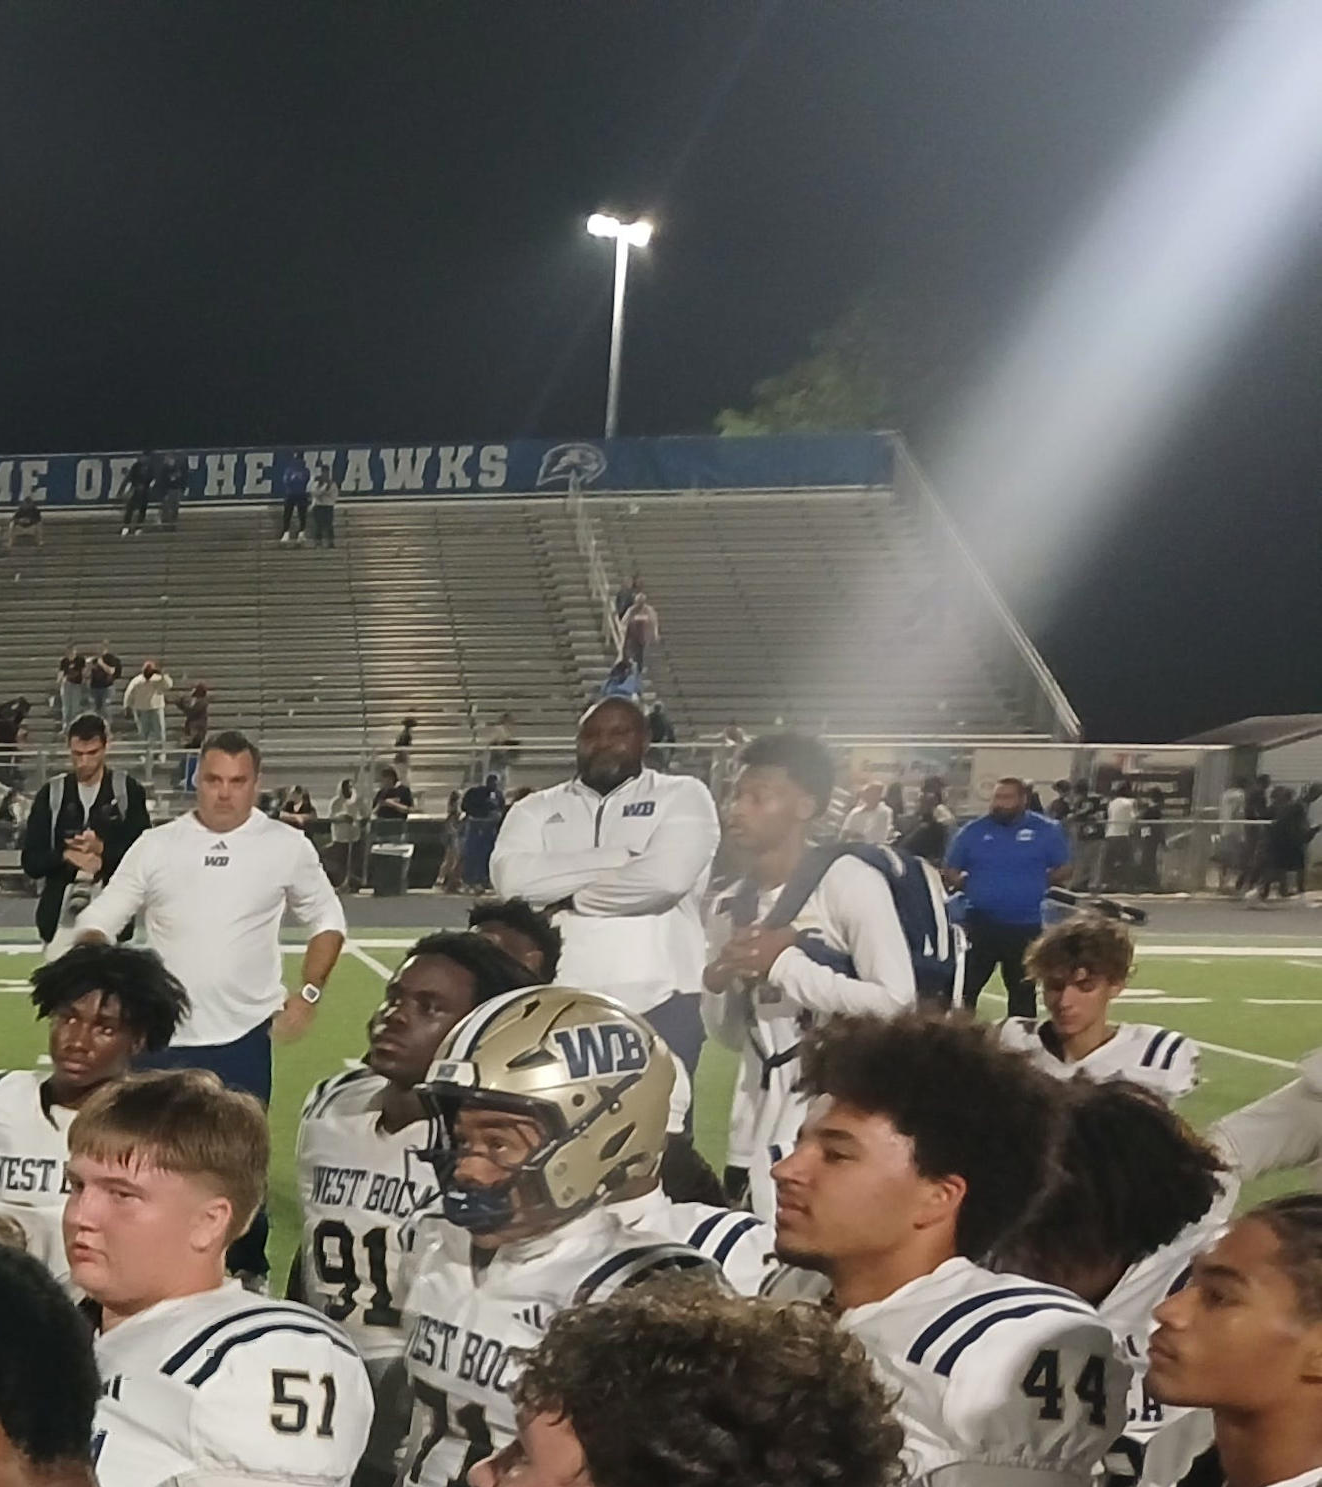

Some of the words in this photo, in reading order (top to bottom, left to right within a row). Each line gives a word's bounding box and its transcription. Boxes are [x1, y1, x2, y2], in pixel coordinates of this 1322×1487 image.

[183, 453, 274, 496] HE
[622, 801, 655, 817] WB
[205, 855, 230, 867] WB
[553, 1023, 649, 1080] WB
[312, 1166, 367, 1206] WEST
[313, 1220, 402, 1326] 91
[270, 1369, 337, 1439] 51
[1023, 1350, 1107, 1426] 44
